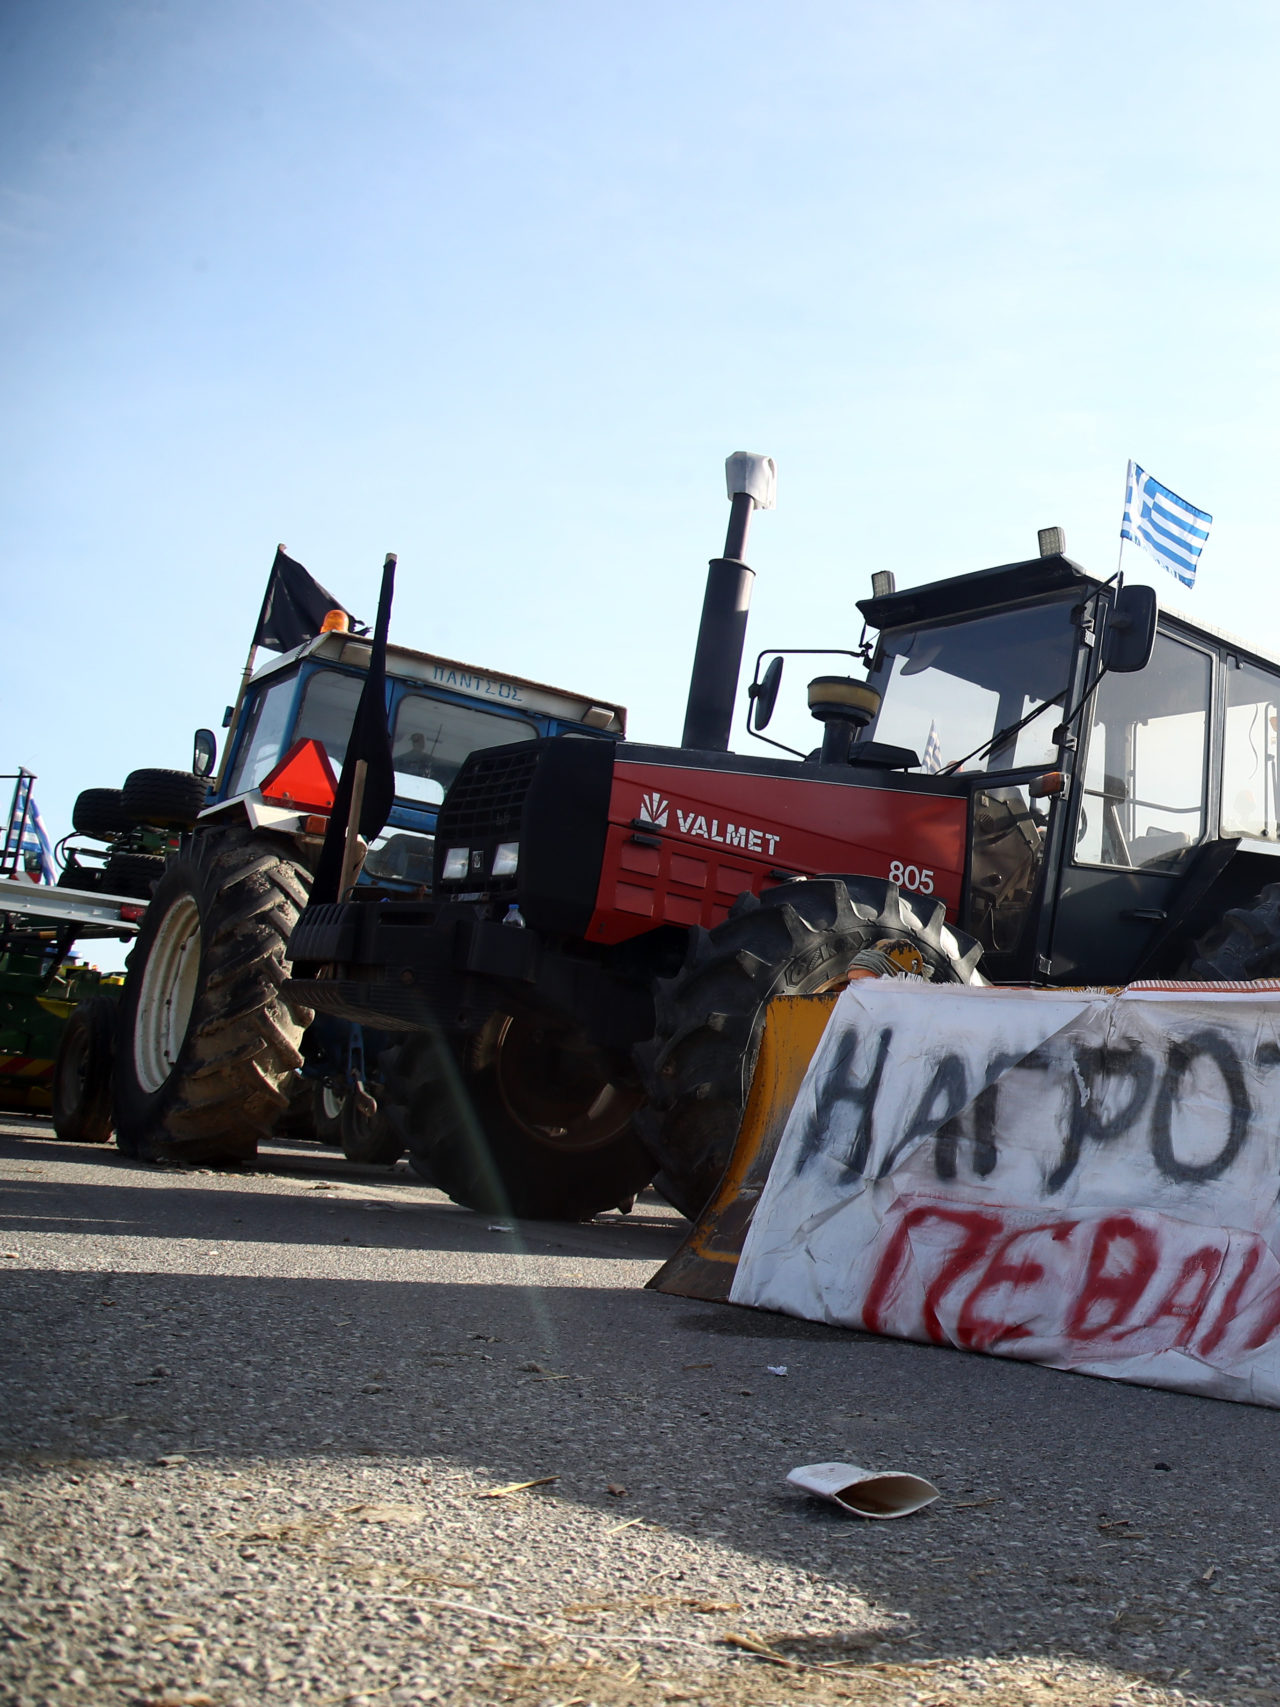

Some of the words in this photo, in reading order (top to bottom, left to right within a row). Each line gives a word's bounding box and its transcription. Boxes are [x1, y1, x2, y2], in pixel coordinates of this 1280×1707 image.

[433, 665, 524, 702] ΠΑΝΤΣΟΣ
[676, 808, 780, 856] VALMET
[888, 860, 935, 895] 805
